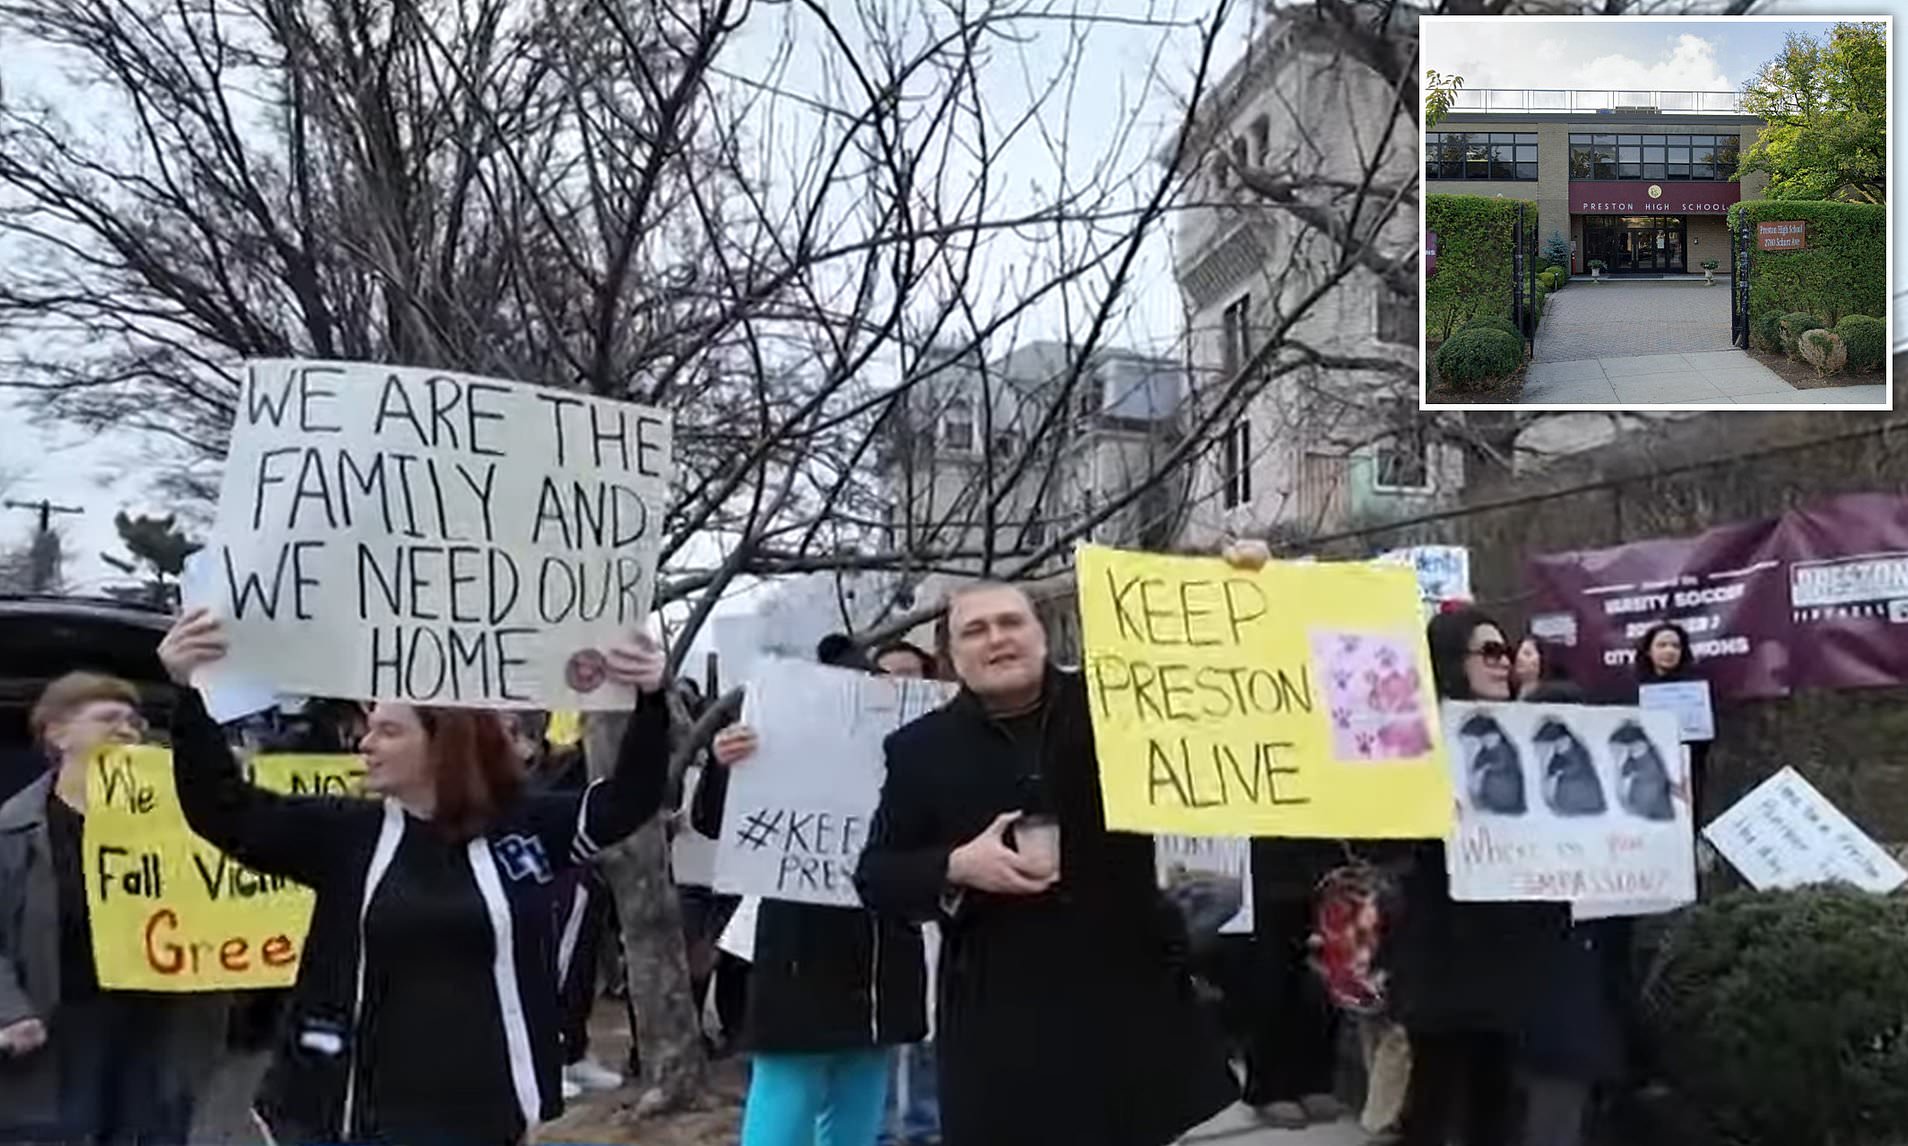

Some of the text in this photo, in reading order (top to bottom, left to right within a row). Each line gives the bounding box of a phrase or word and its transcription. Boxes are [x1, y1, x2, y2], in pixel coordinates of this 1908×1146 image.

[1583, 202, 1727, 211] PRESTON HIGH SCHOOL
[1760, 225, 1776, 234] Preston
[1789, 224, 1803, 234] School
[248, 364, 663, 478] WE ARE THE
[253, 447, 648, 551] FAMILY AND
[223, 541, 643, 626] WE NEED OUR
[1105, 566, 1269, 647] KEEP
[371, 625, 540, 702] HOME
[1093, 654, 1313, 722] PRESTON
[98, 753, 156, 815] We
[1147, 737, 1312, 808] ALIVE
[736, 808, 860, 855] #KEE
[98, 845, 162, 903] Fall
[144, 908, 298, 975] Gree
